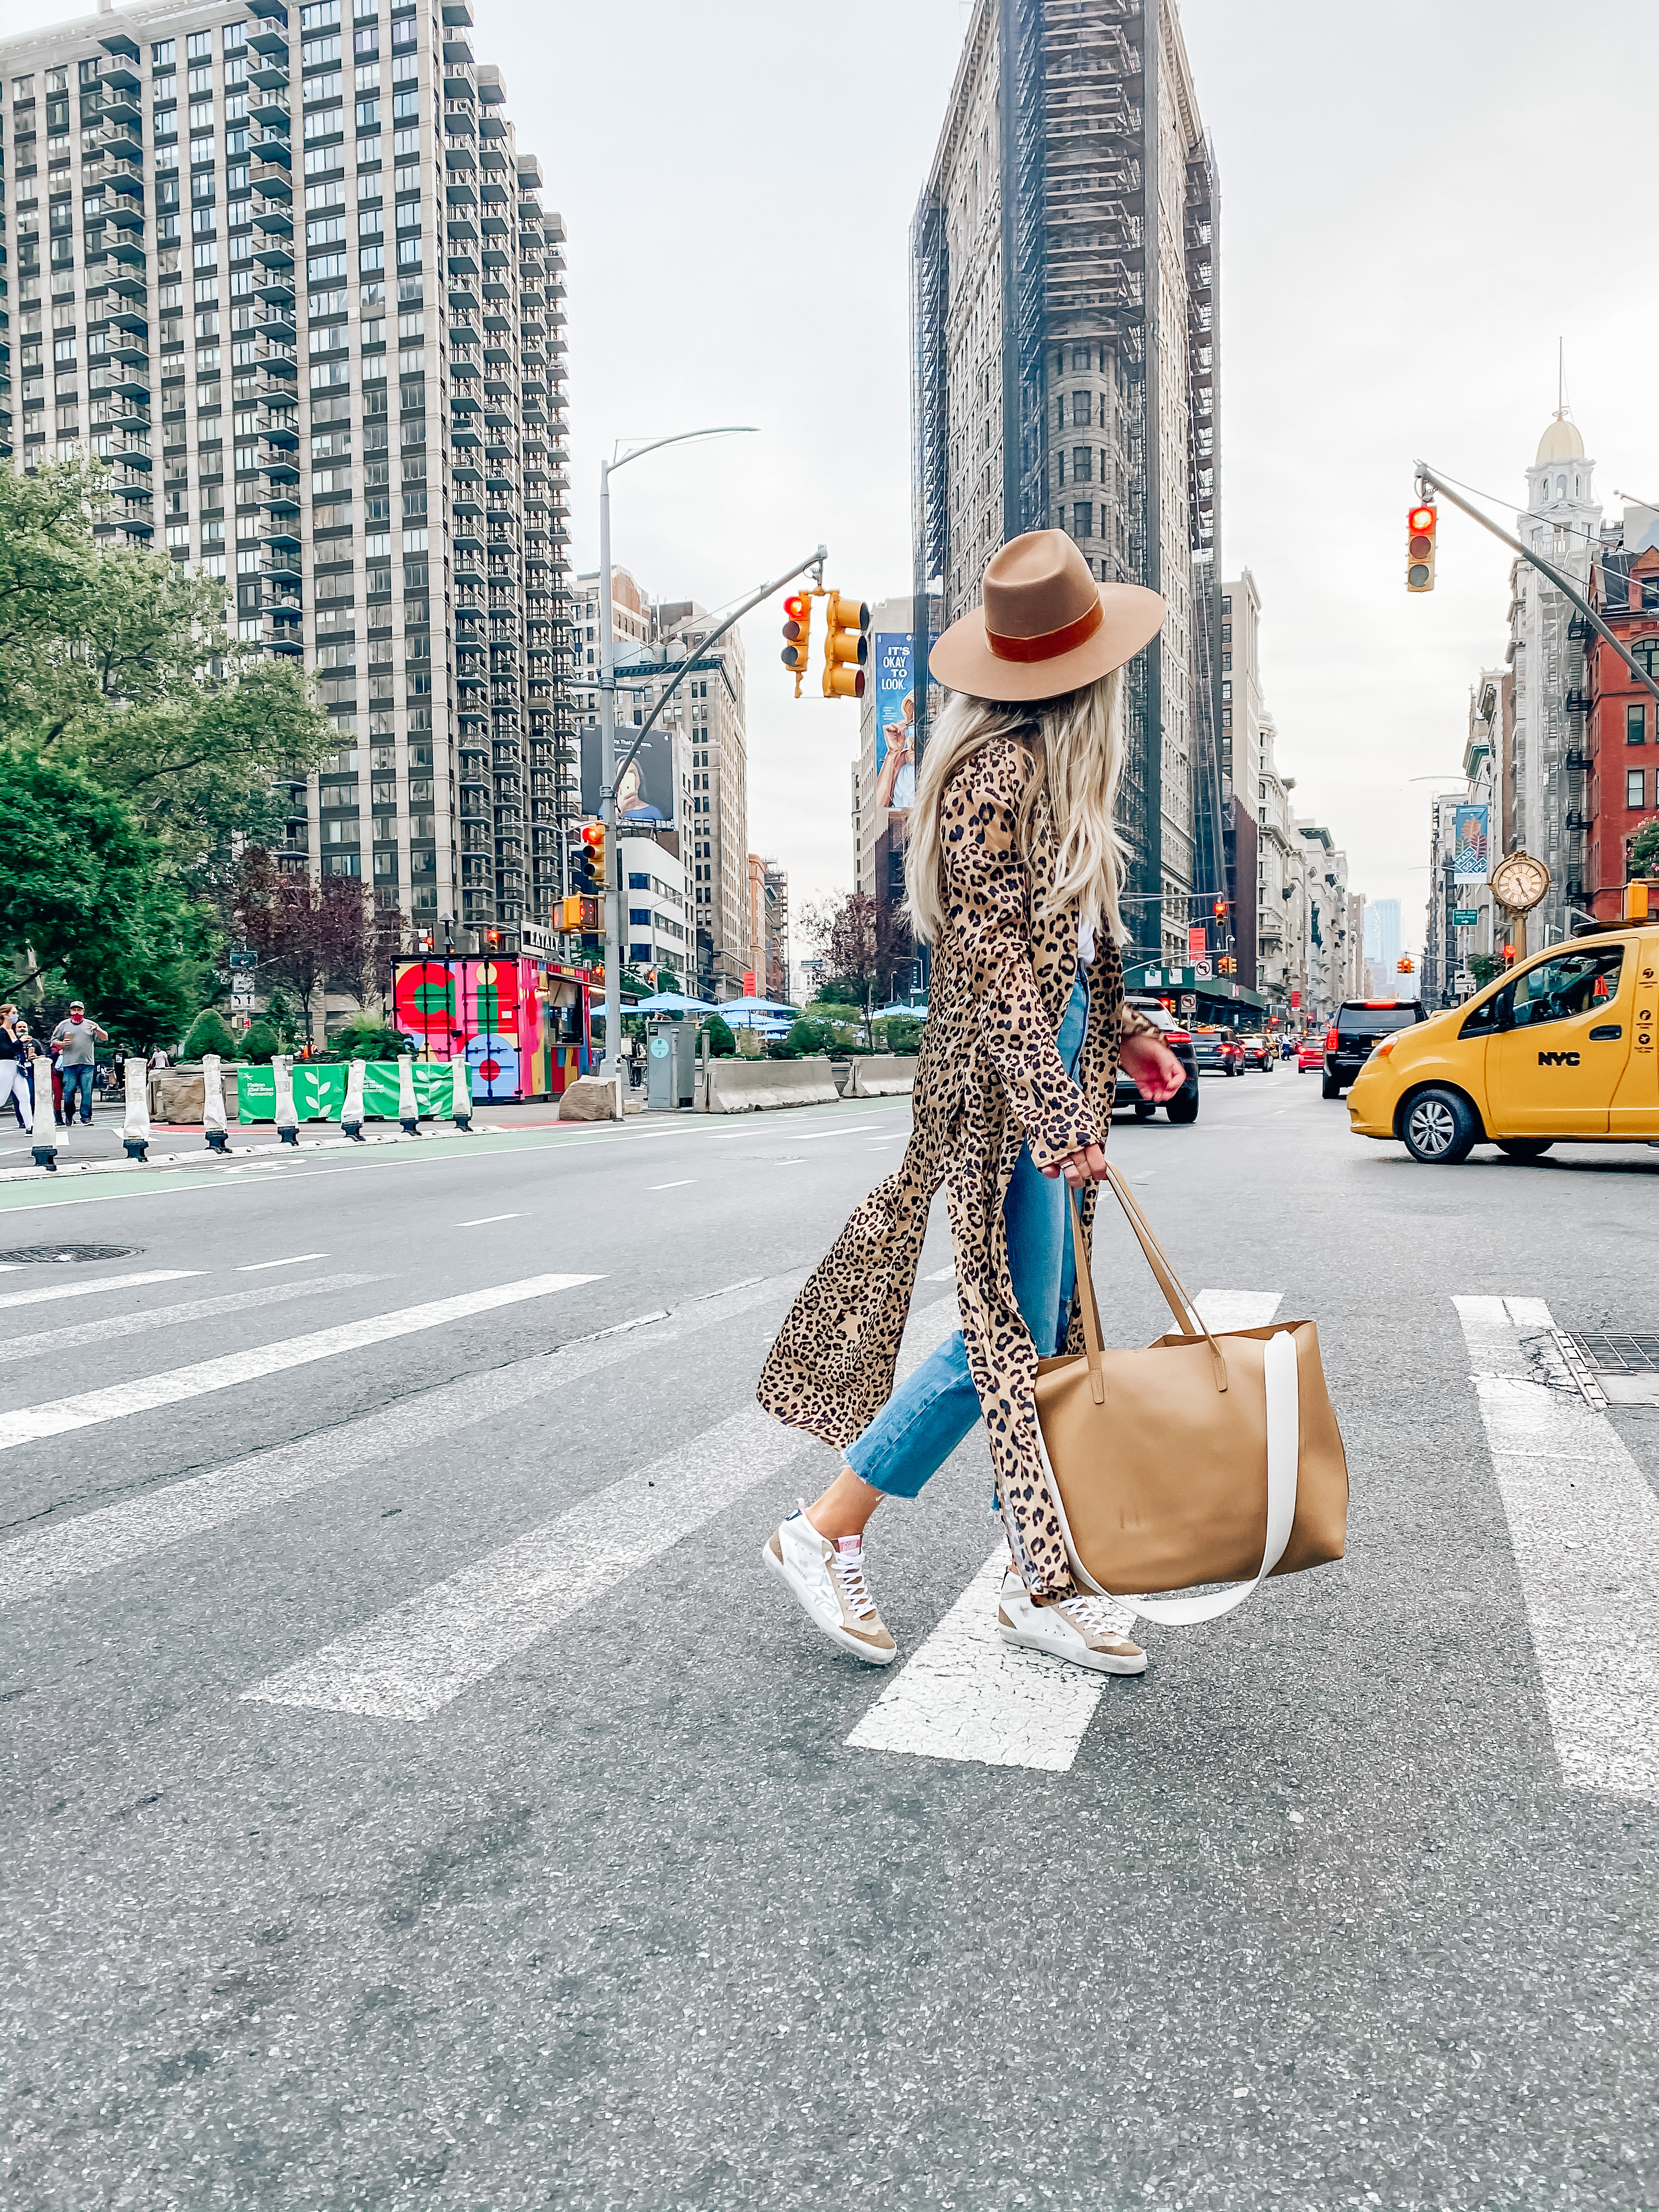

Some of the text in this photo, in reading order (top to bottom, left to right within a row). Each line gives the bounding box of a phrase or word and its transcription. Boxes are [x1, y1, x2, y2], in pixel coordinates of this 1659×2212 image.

[888, 646, 911, 656] IT'S
[883, 657, 906, 668] OKAY
[890, 669, 908, 678] TO
[882, 679, 906, 690] LOOK.
[1455, 851, 1475, 866] MAD.
[1462, 861, 1476, 871] SQ.
[1473, 862, 1487, 872] PK.
[530, 930, 560, 952] EATALY
[1538, 1051, 1581, 1066] NYC
